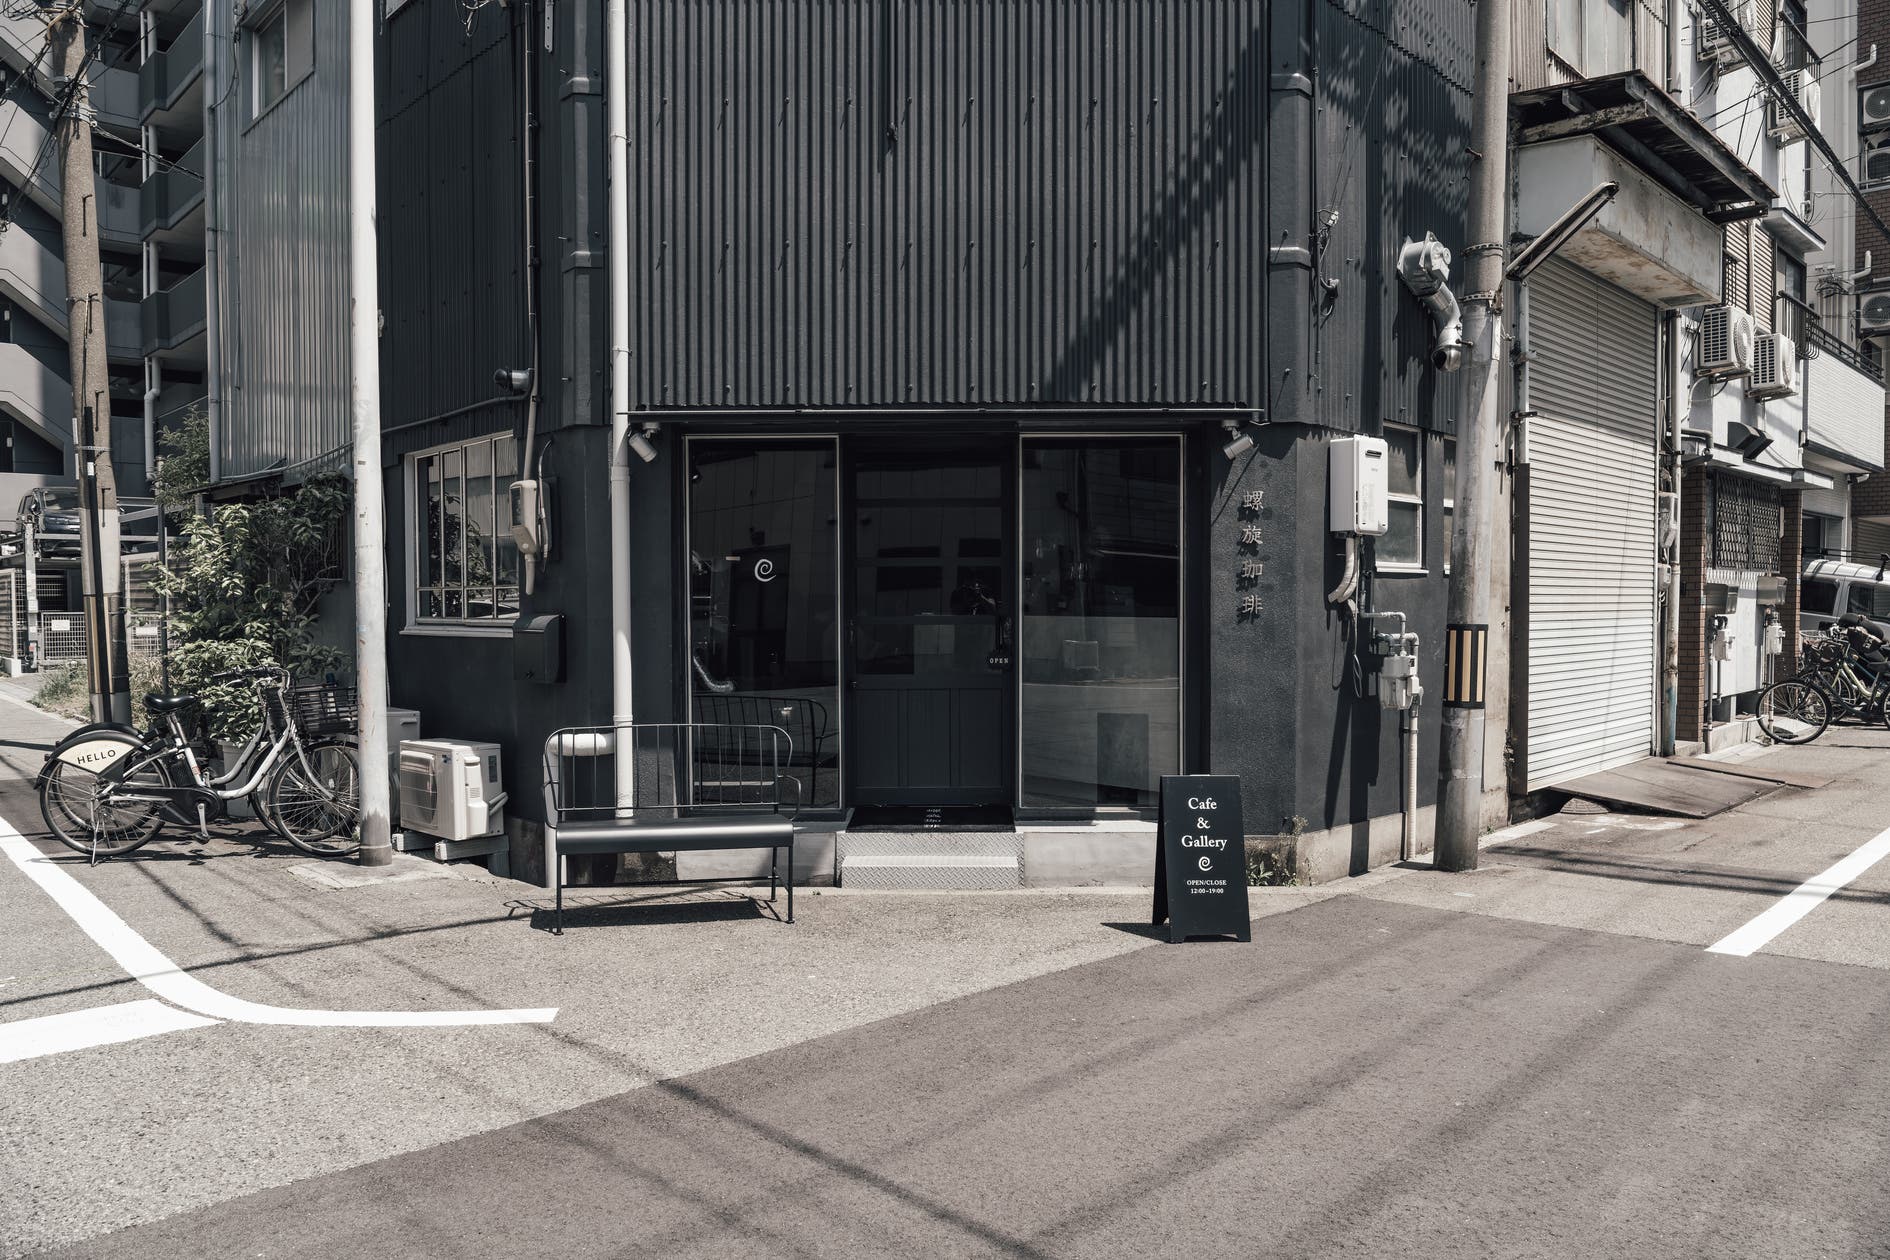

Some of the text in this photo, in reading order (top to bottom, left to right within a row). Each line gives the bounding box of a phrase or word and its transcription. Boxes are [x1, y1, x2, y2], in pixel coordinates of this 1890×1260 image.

[1241, 490, 1264, 614] 螺旋珈琲
[77, 749, 116, 765] HELLO
[1187, 797, 1218, 810] Cafe
[1196, 817, 1211, 829] &
[1181, 835, 1228, 851] Gallery
